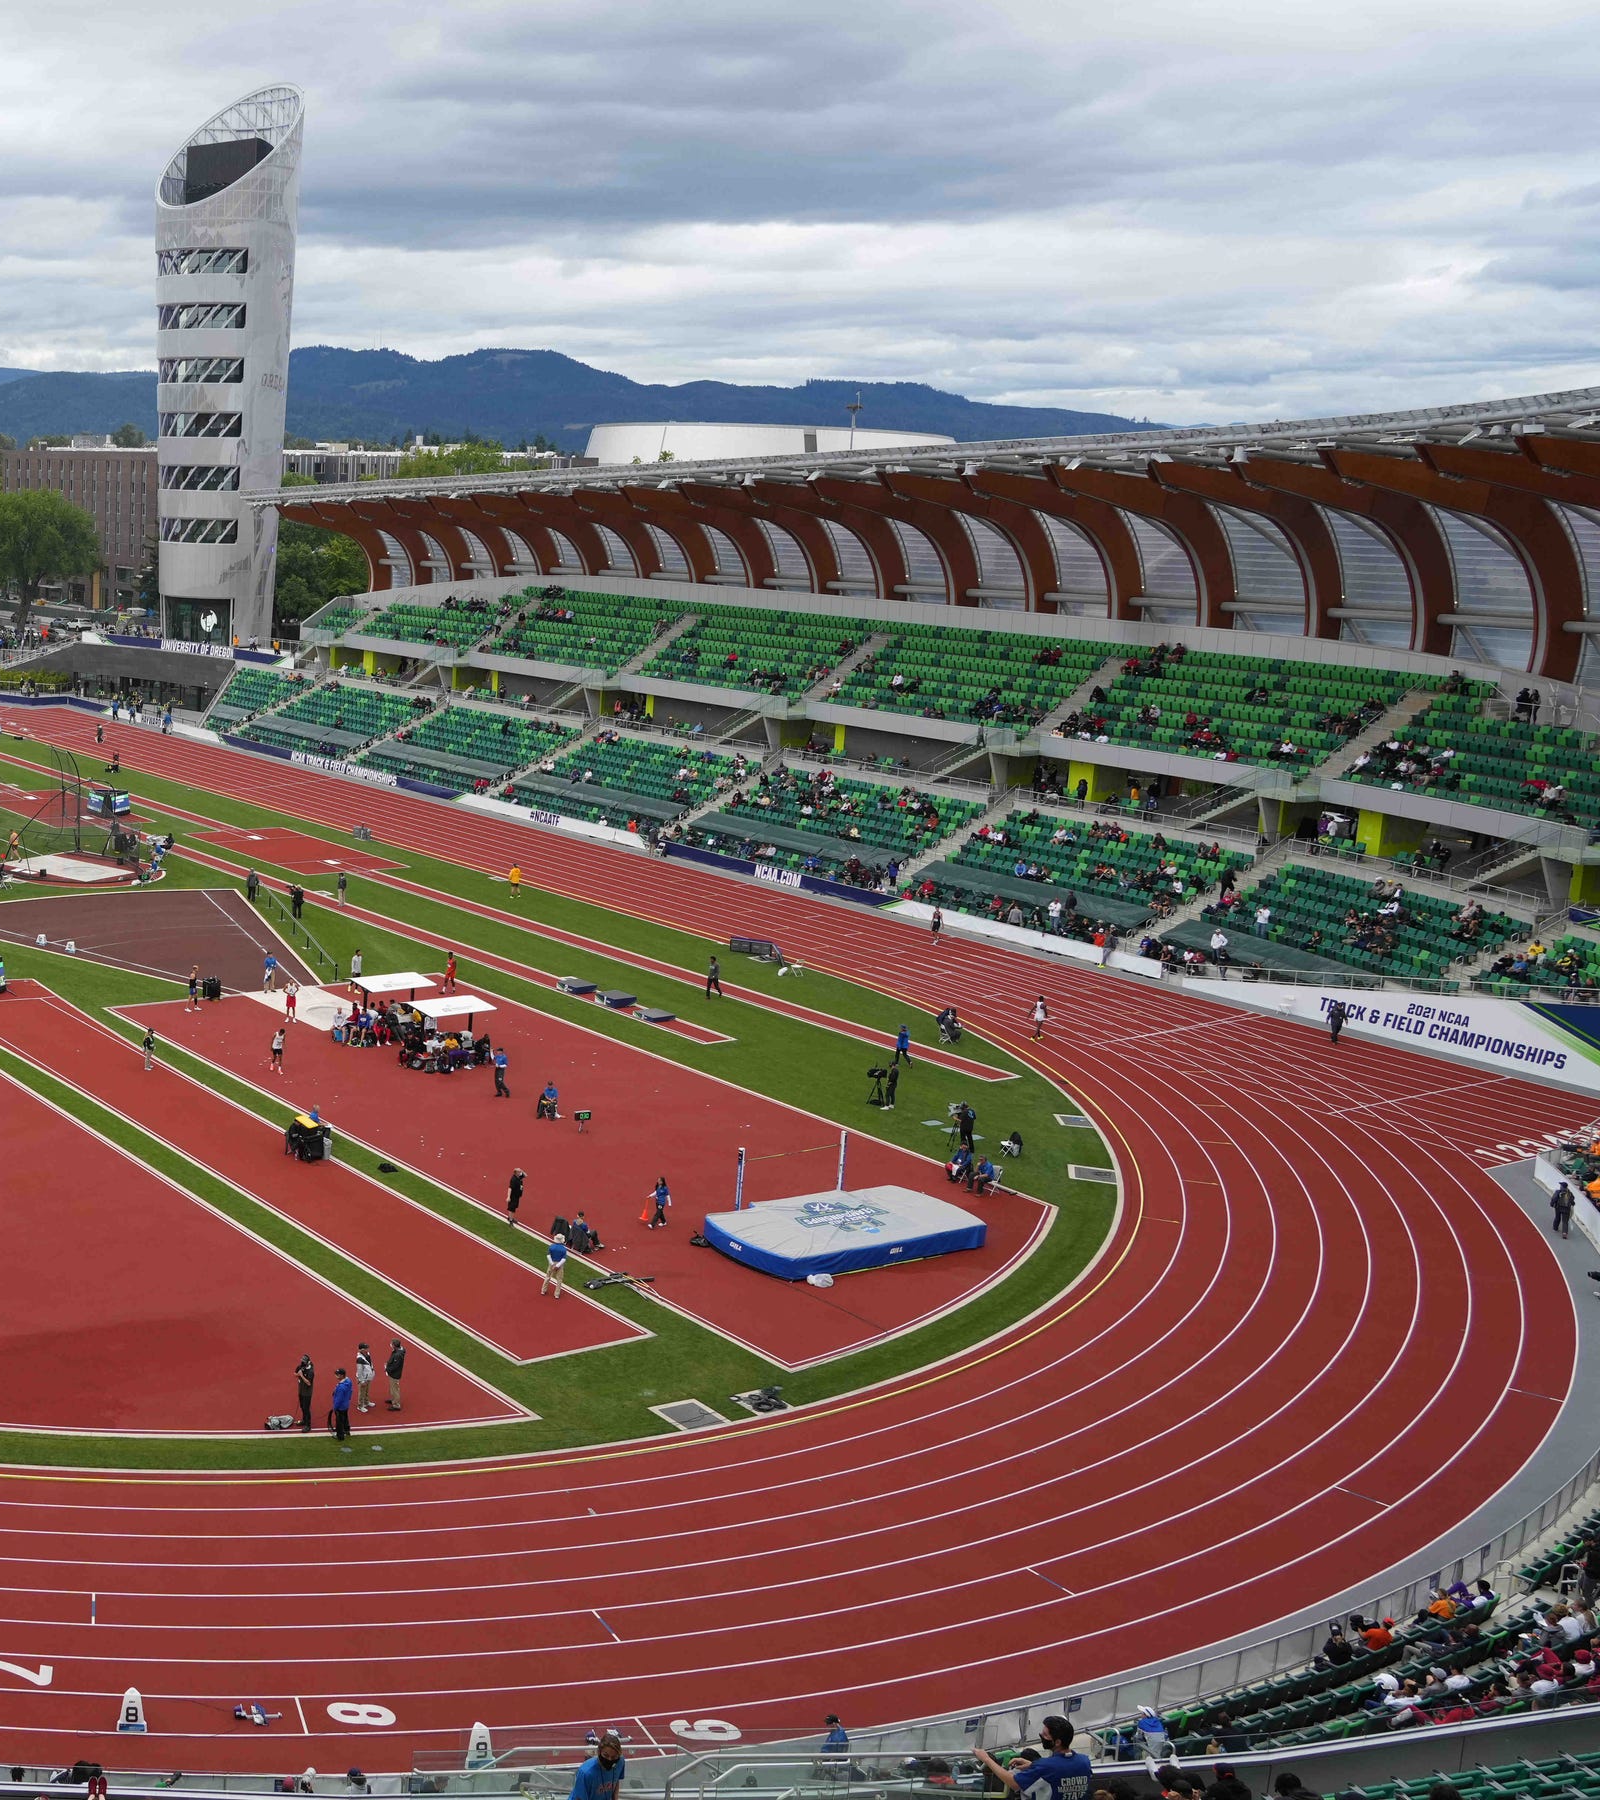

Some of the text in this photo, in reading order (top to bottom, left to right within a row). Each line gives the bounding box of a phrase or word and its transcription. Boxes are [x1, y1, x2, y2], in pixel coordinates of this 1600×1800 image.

[161, 640, 200, 654] UNIVERSITY
[200, 643, 210, 654] OF
[290, 751, 397, 786] NCAA TRACK & FIELD CHAMPIONSHIPS
[530, 810, 560, 826] #NCAATF
[754, 864, 802, 888] NCAA.COM
[1406, 1003, 1470, 1028] 2021 NCAA
[1368, 1008, 1380, 1024] &
[1383, 1013, 1424, 1036] FIELD
[1428, 1024, 1568, 1070] CHAMPIONSHIPS
[1474, 1149, 1512, 1162] 1
[1496, 1144, 1537, 1158] 2
[730, 1241, 742, 1252] GILL
[125, 1706, 138, 1722] 8
[326, 1702, 397, 1726] 8
[669, 1718, 742, 1741] 9
[476, 1742, 488, 1759] 9
[1061, 1776, 1088, 1786] CROWD
[1062, 1792, 1086, 1800] STAFF
